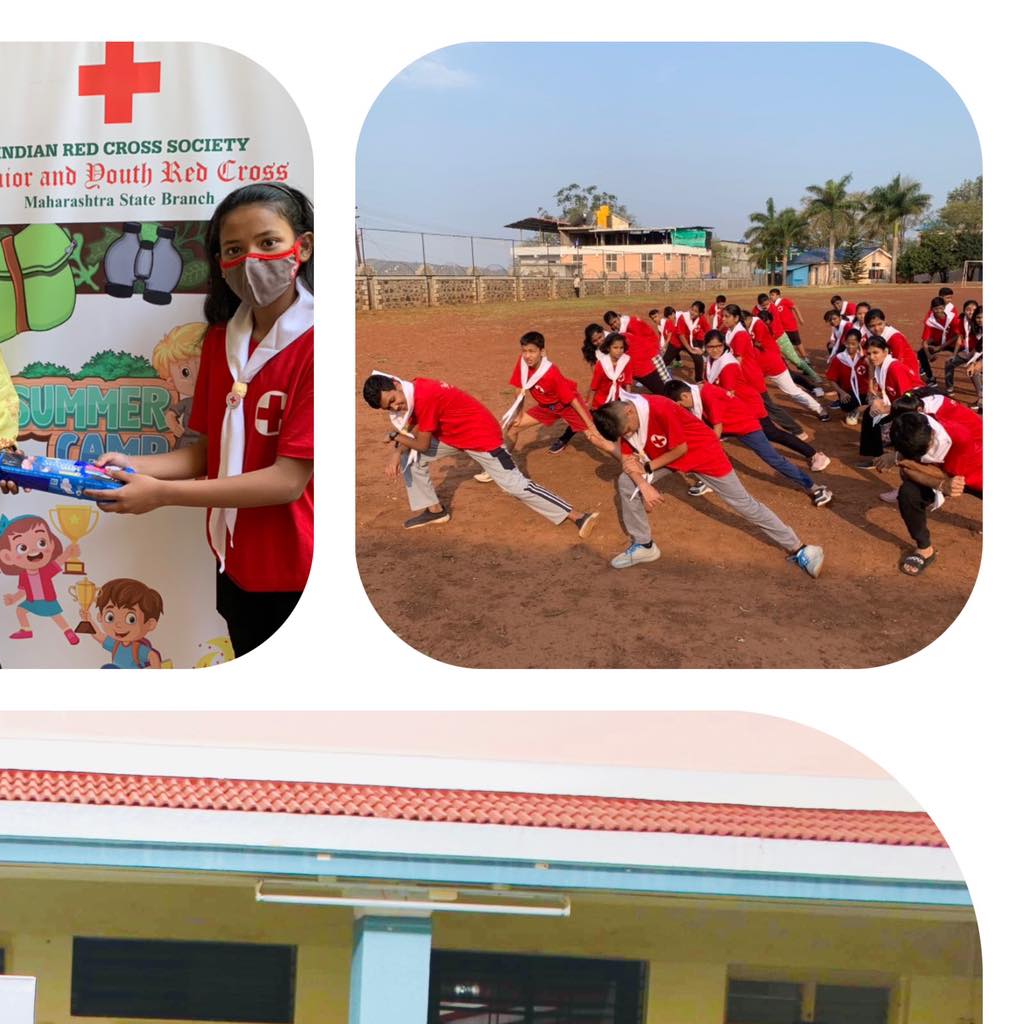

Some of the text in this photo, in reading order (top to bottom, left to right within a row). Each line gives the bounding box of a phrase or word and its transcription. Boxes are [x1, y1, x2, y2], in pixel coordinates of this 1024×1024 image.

[62, 142, 99, 157] RED
[103, 140, 162, 156] CROSS
[166, 137, 250, 154] SOCIETY
[39, 166, 77, 187] and
[84, 162, 152, 190] Youth
[160, 160, 208, 184] Red
[217, 159, 290, 182] Cross
[24, 191, 215, 209] Maharashtra State Branch
[16, 384, 171, 431] SUMMER
